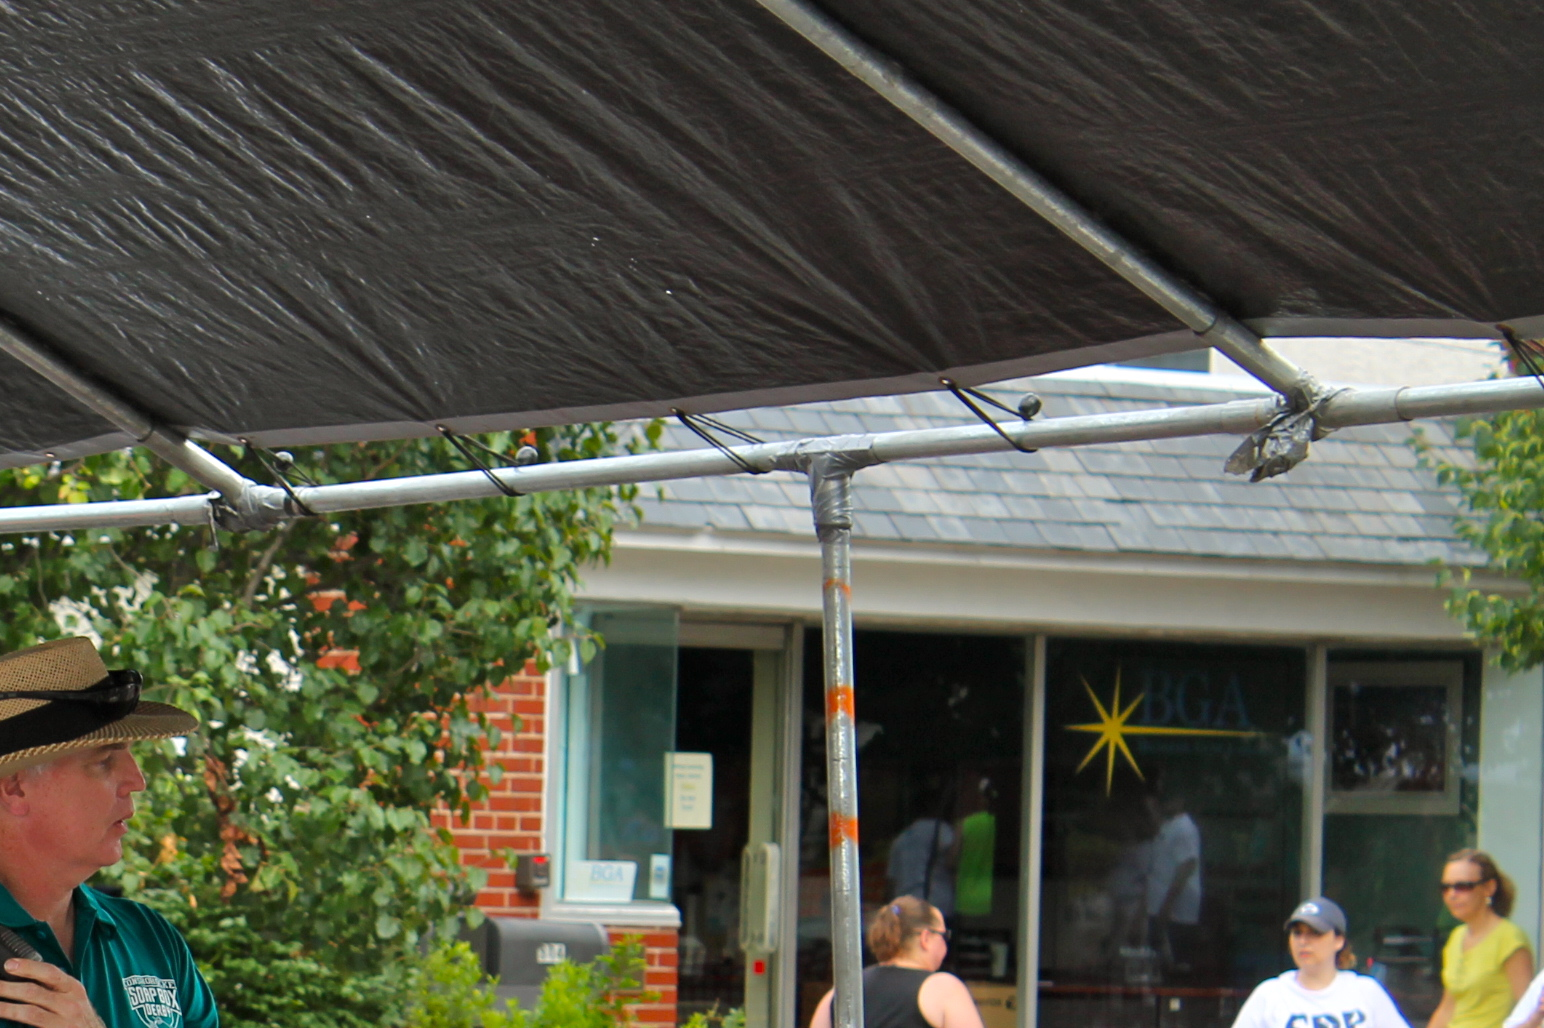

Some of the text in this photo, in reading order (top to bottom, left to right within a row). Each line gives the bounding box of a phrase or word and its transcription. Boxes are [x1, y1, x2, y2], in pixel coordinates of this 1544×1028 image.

[1141, 668, 1252, 727] BGA
[128, 986, 180, 1011] SOAP BOX
[144, 1003, 173, 1018] DERBY
